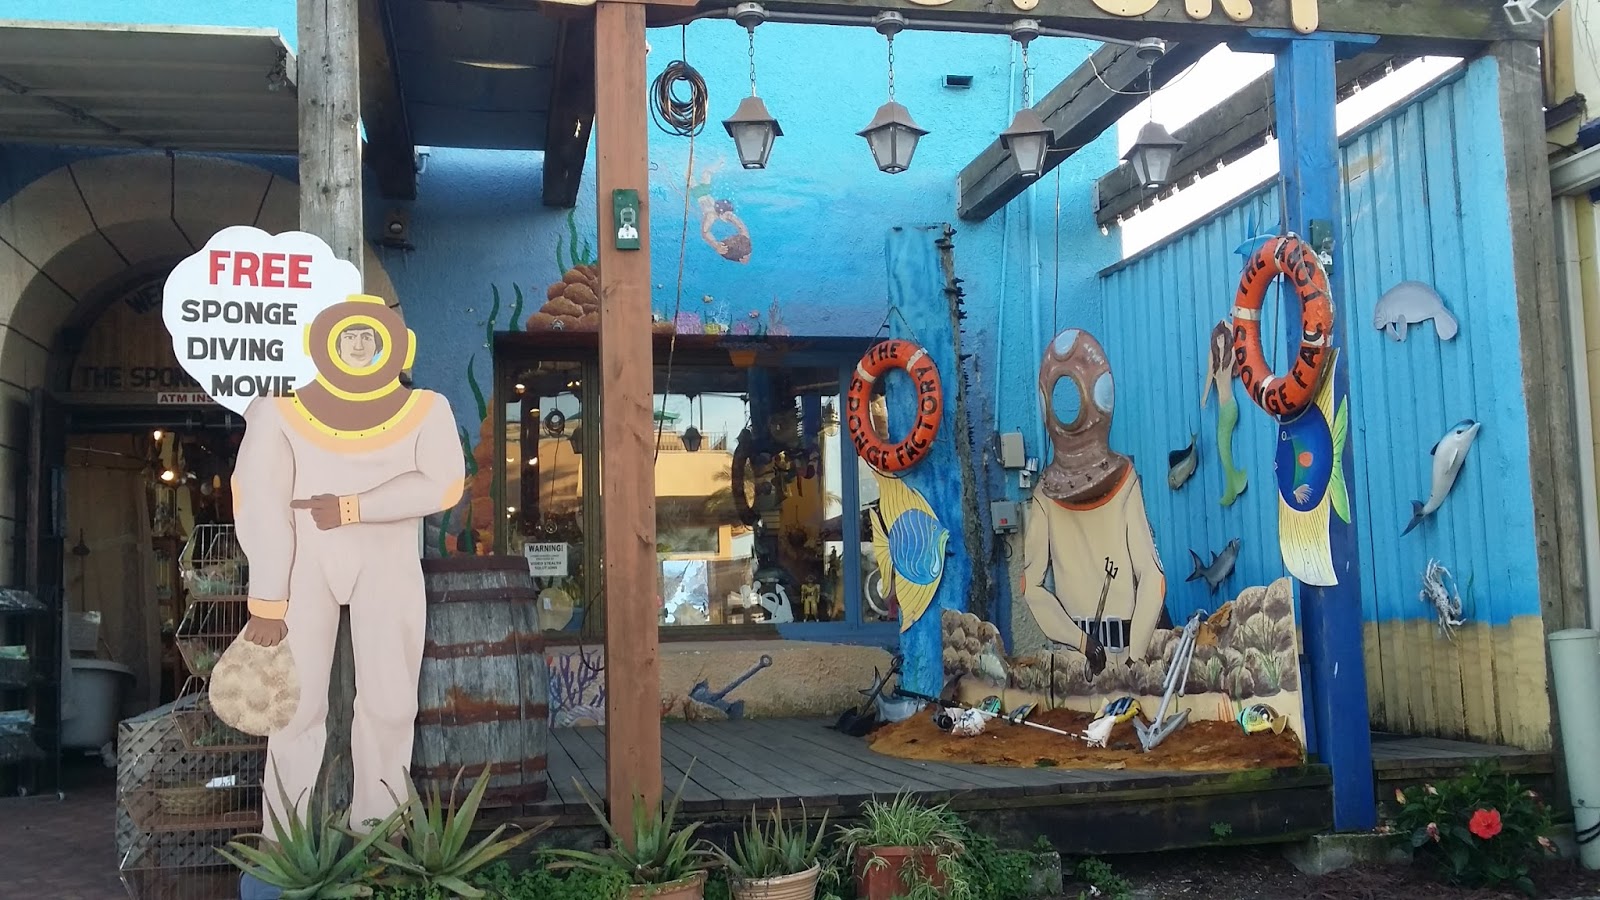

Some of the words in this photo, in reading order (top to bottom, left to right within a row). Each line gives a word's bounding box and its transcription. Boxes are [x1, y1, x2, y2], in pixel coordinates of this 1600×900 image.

[209, 249, 313, 289] FREE
[181, 299, 298, 326] SPONGE
[187, 336, 284, 362] DIVING
[867, 342, 900, 366] THE
[80, 366, 122, 387] THE
[130, 366, 200, 387] SPON
[1234, 325, 1296, 415] SPONGE
[160, 394, 187, 403] ATM
[192, 394, 214, 403] INS
[211, 374, 296, 398] MOVIE
[848, 378, 890, 470] SPONGE
[896, 366, 937, 467] FACTORY
[528, 544, 563, 552] WARNING!
